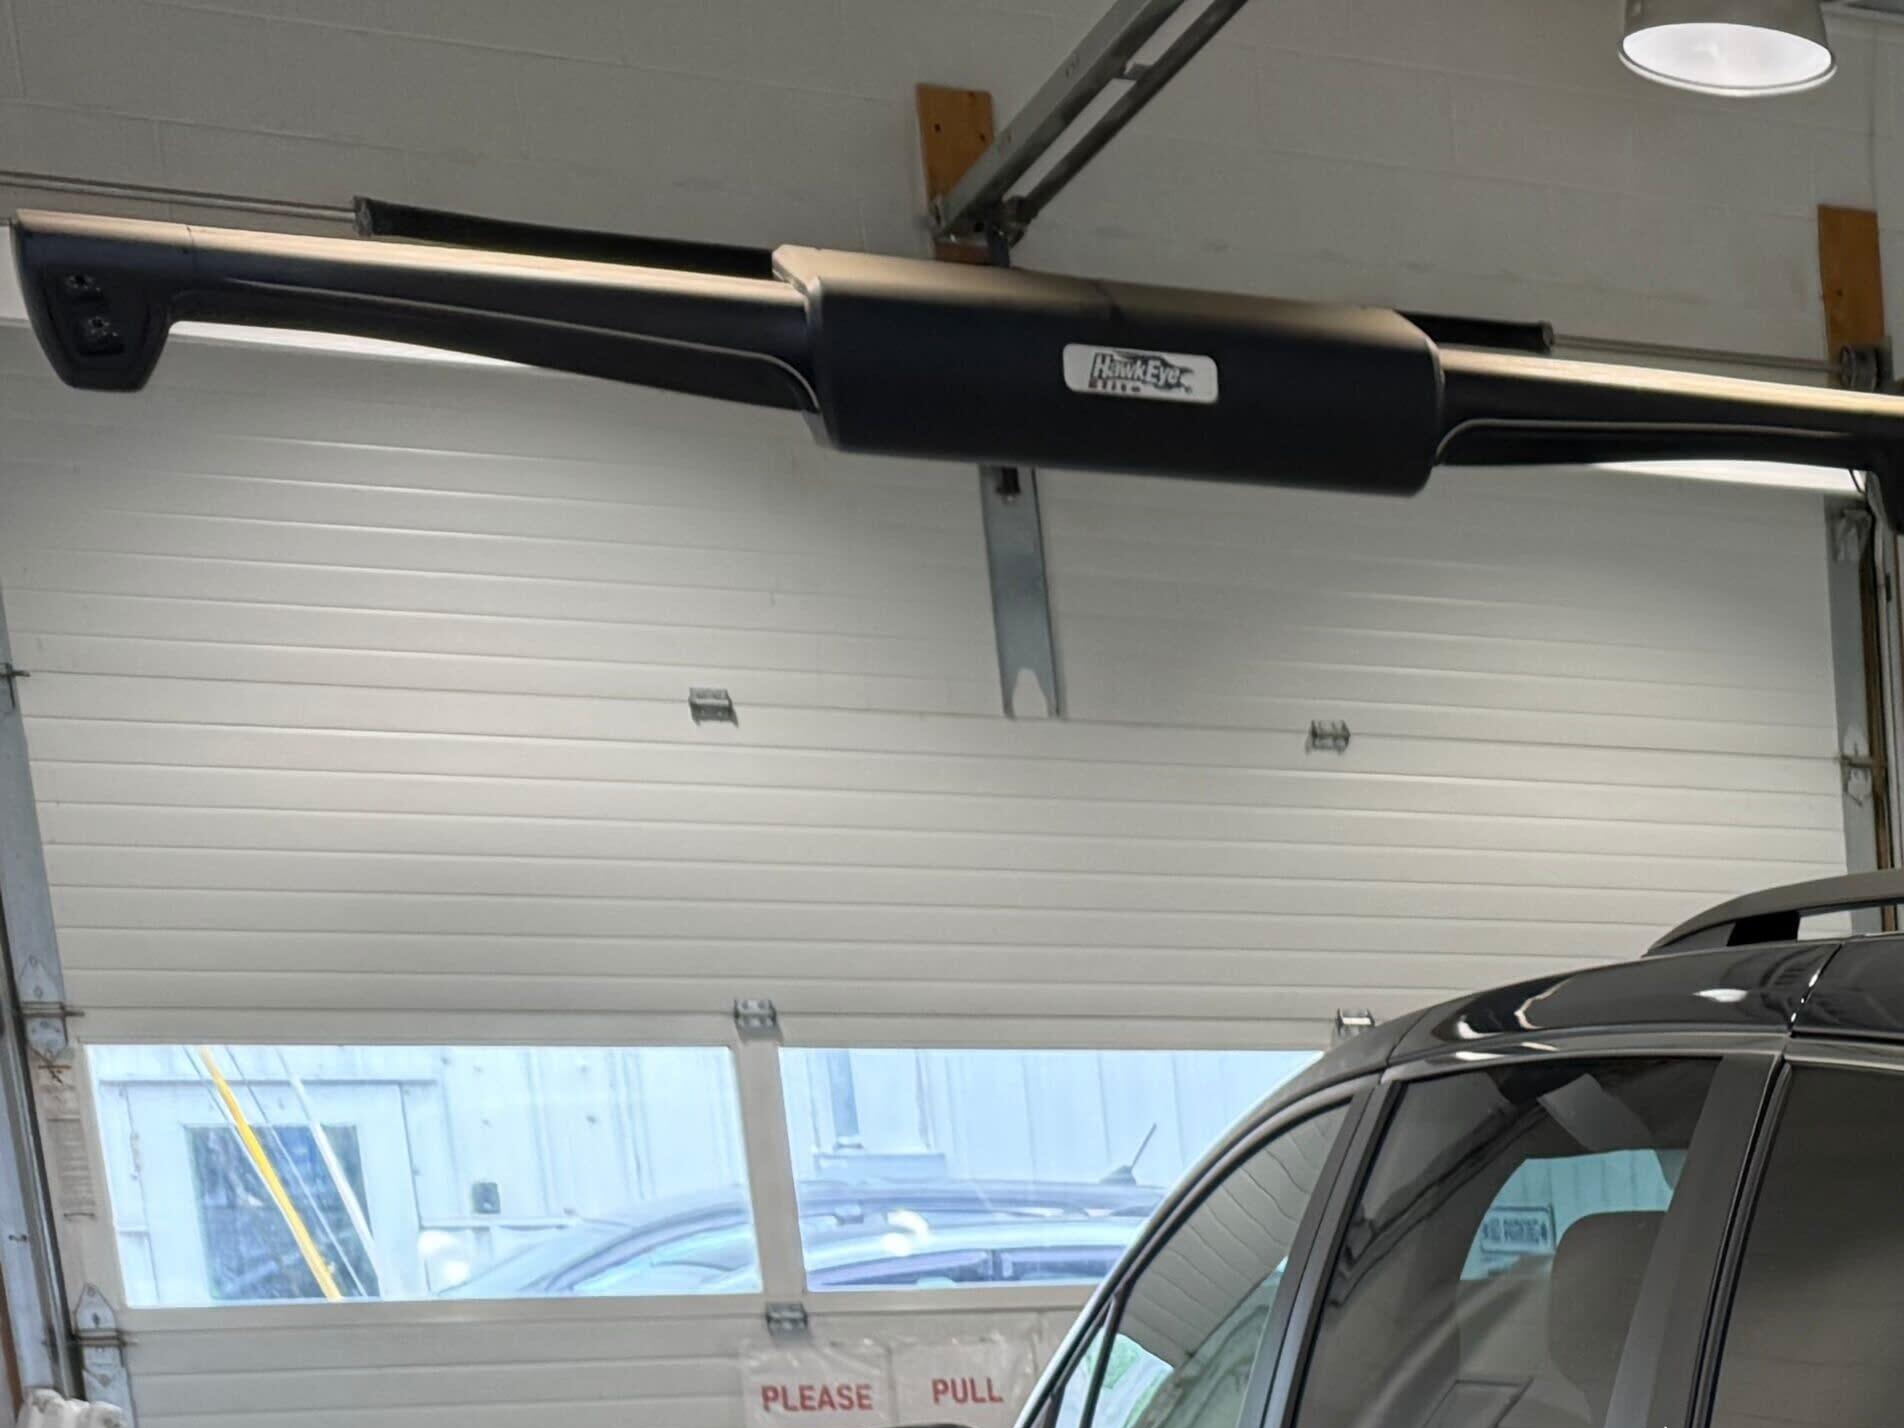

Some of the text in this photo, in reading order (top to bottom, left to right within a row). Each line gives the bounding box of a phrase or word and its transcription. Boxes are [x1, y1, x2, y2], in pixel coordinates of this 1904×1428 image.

[1090, 352, 1181, 387] HawkEye
[760, 1376, 1004, 1413] PLEASE PULL
